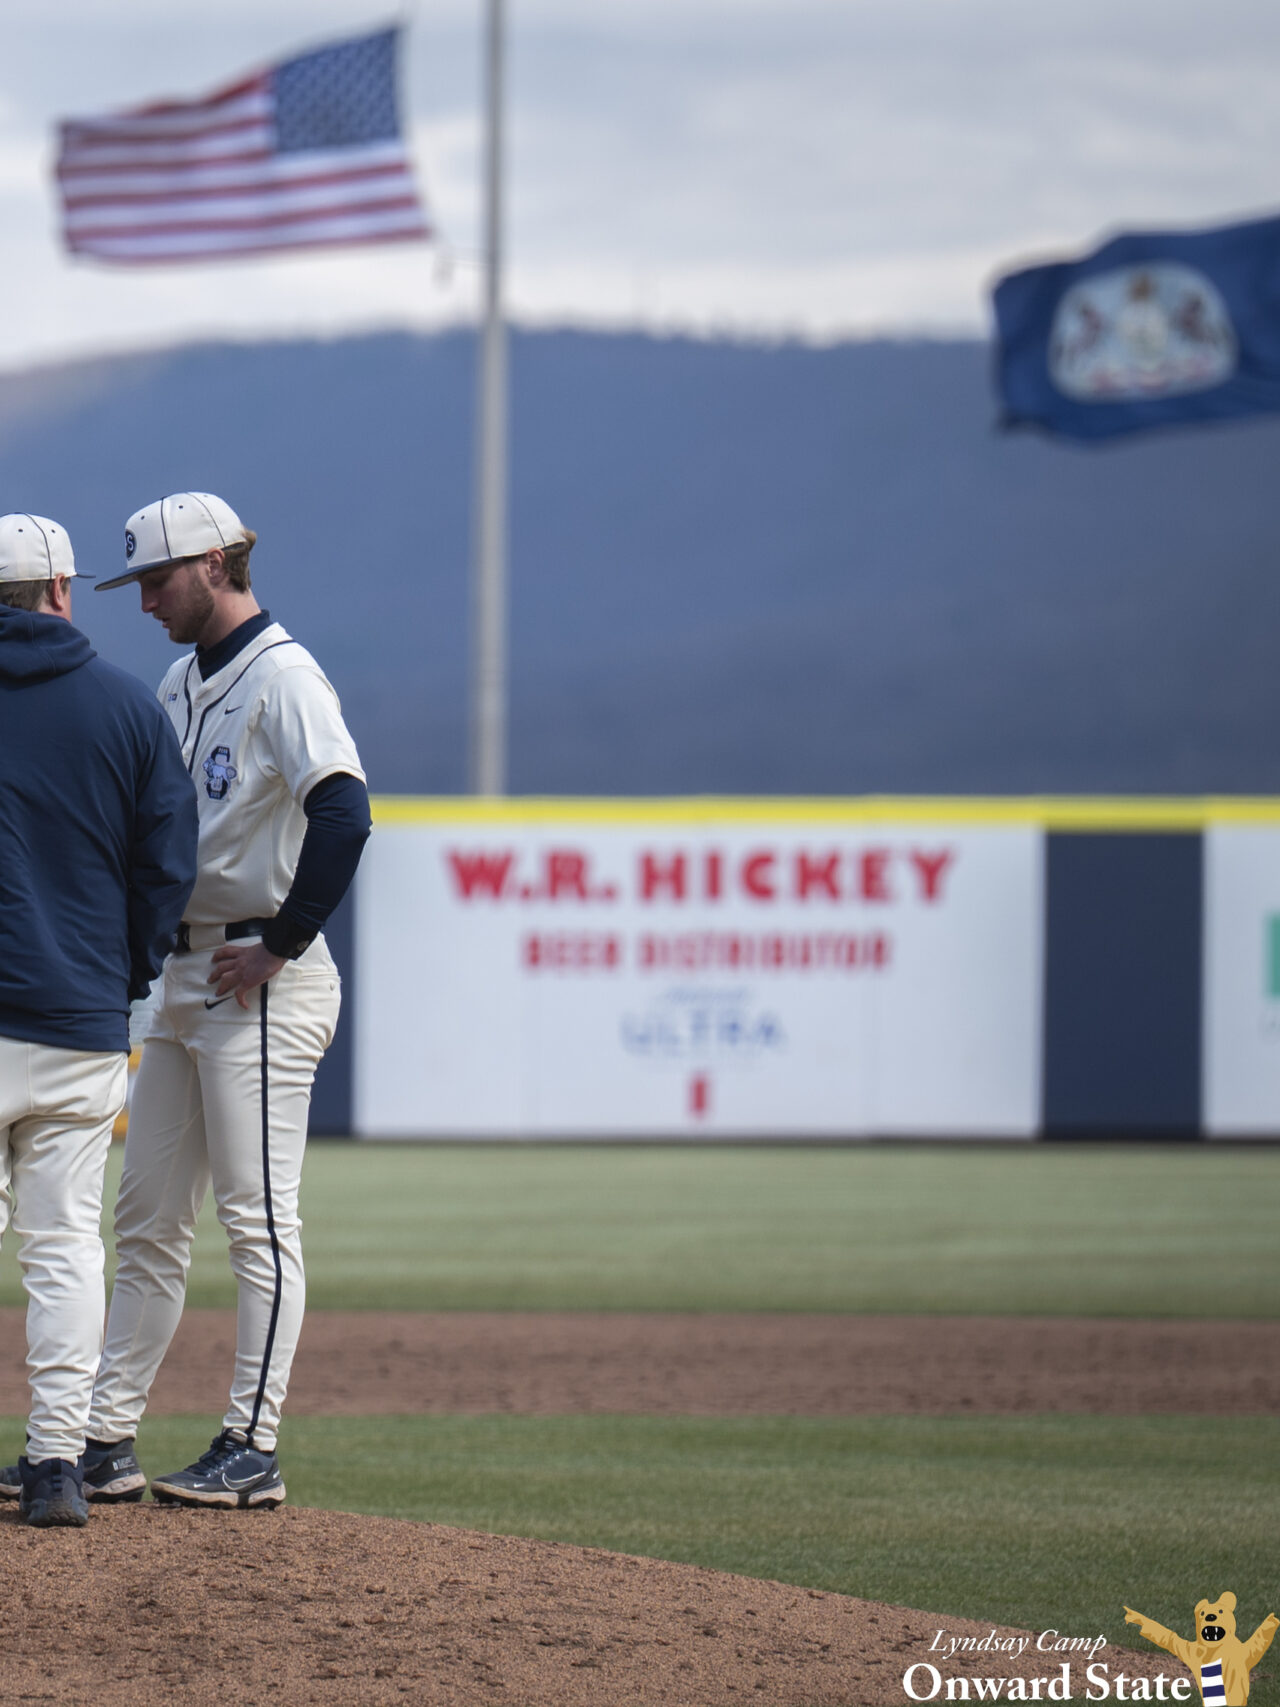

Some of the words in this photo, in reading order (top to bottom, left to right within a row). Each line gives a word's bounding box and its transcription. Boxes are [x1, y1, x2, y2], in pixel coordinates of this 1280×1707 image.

[447, 850, 619, 903] W.R.
[639, 850, 954, 903] HICKEY
[521, 930, 619, 973] BEER
[637, 930, 890, 973] DISTRIBUTOR
[621, 1011, 788, 1052] ULTRA
